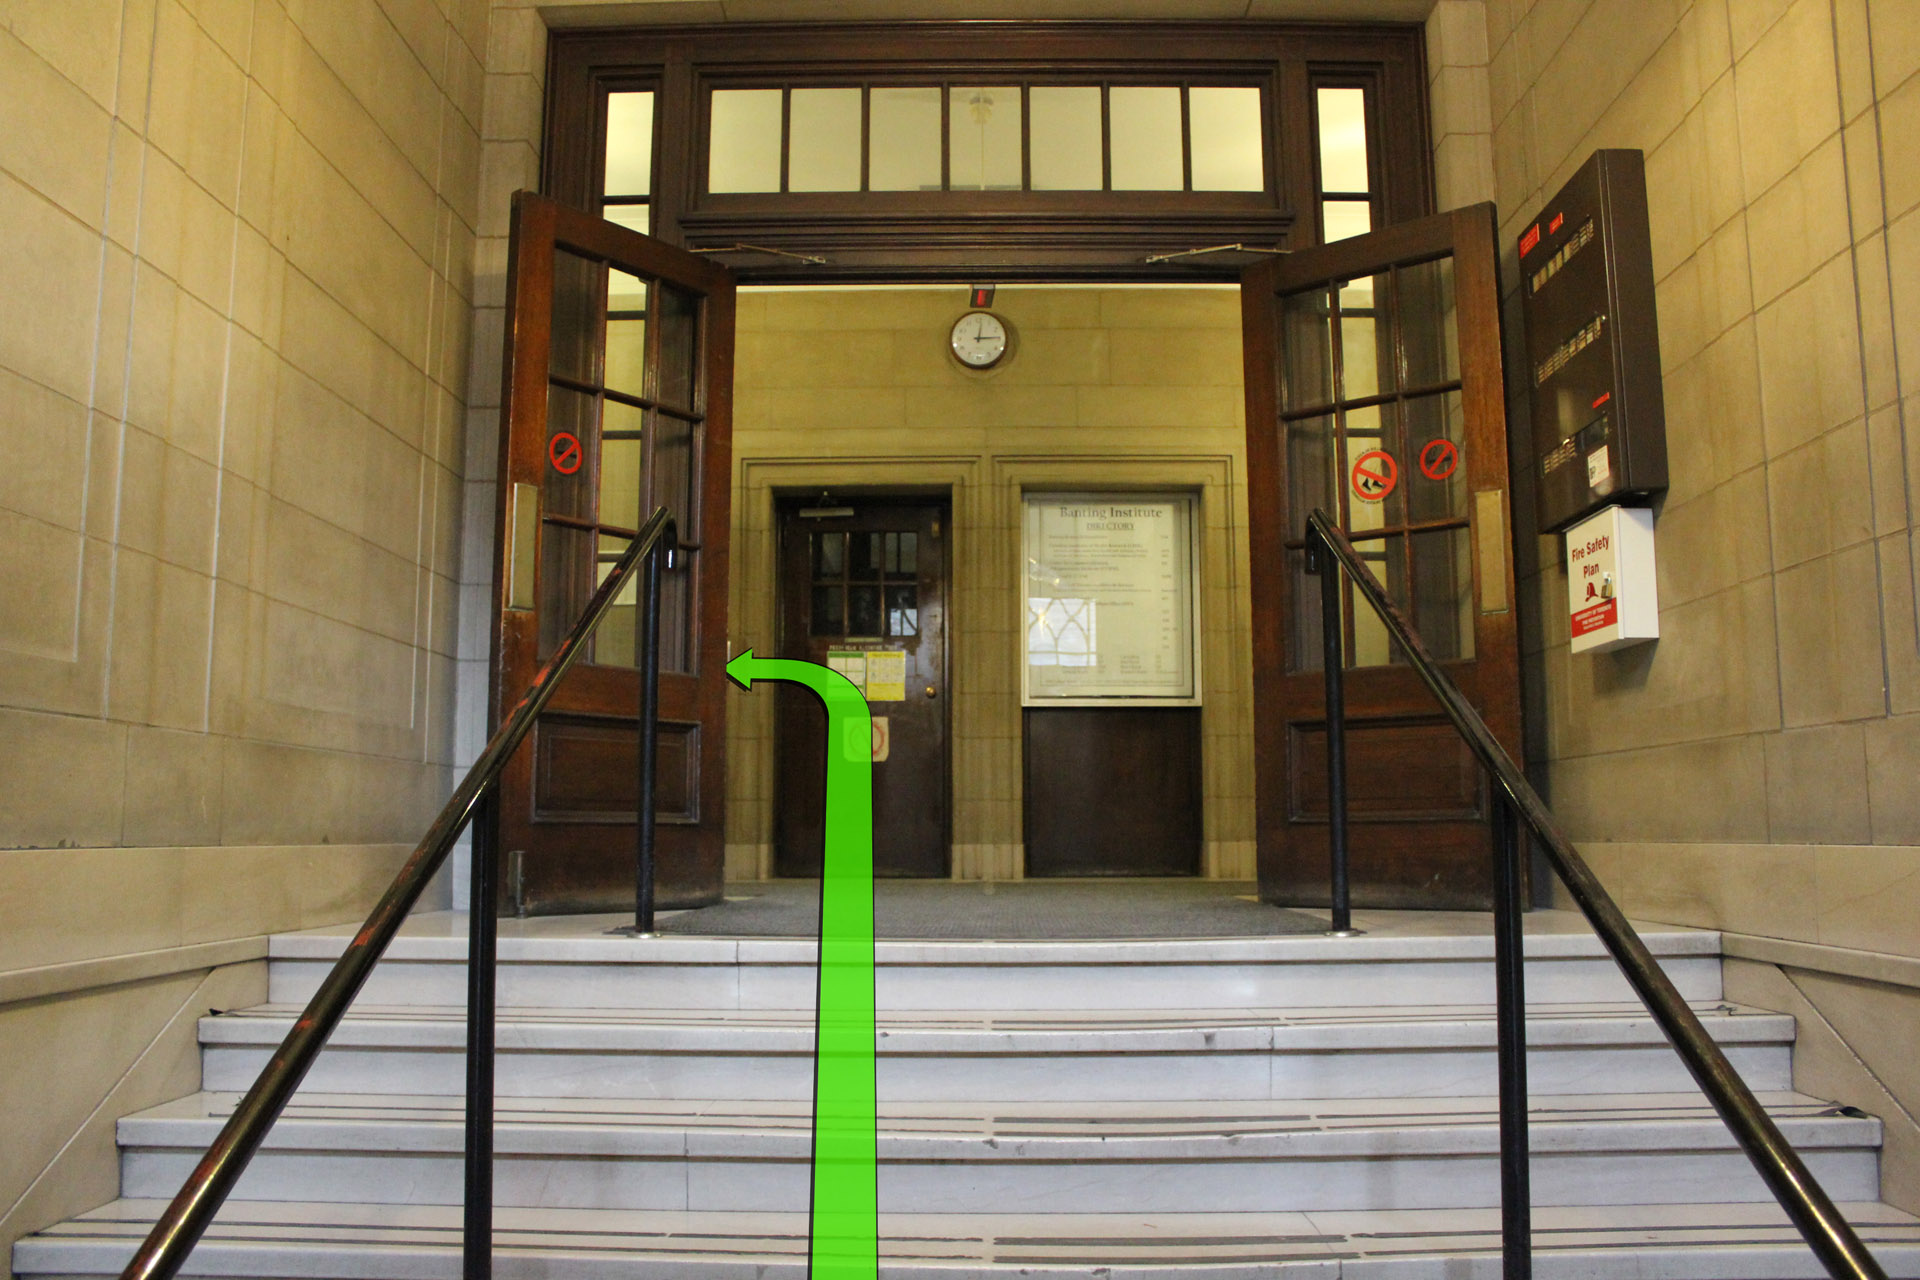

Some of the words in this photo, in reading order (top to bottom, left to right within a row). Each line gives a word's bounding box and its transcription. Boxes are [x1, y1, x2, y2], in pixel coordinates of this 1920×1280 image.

[1060, 507, 1106, 520] Banting
[1110, 507, 1162, 518] Institute
[1086, 522, 1135, 530] DIRECTORY
[1572, 549, 1585, 562] Fire
[1586, 535, 1609, 556] Safety
[1583, 563, 1600, 579] Plan
